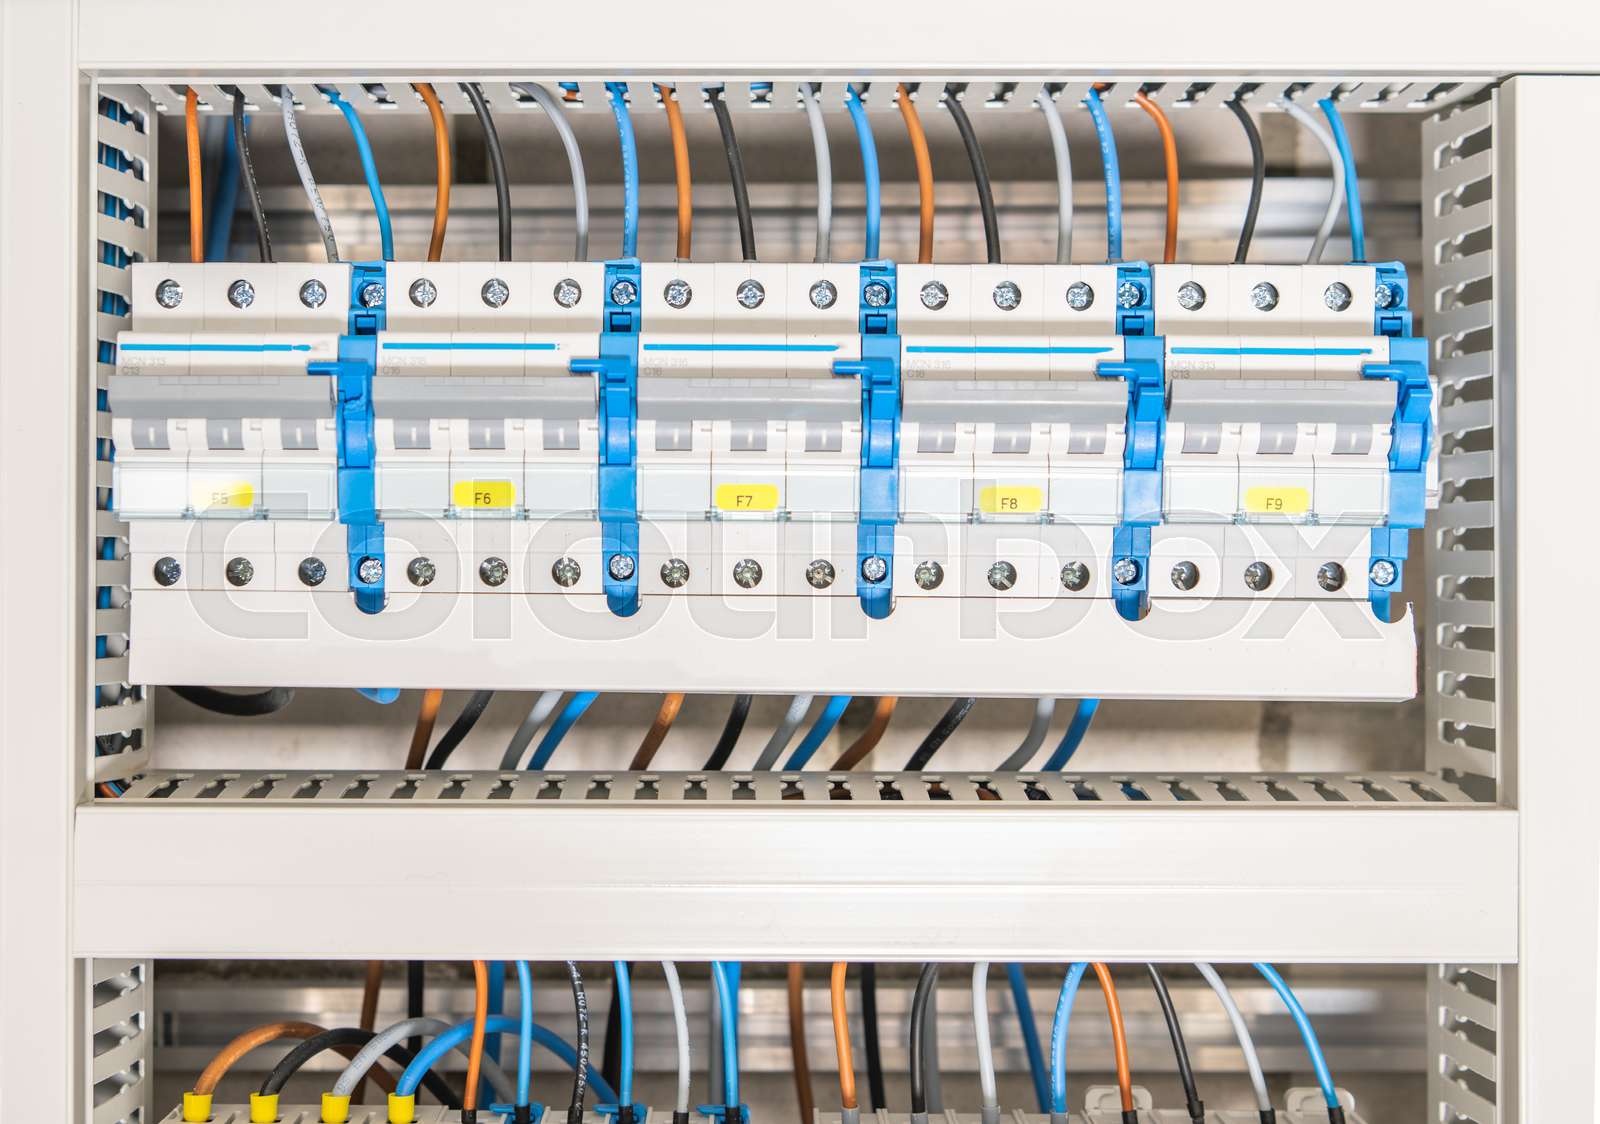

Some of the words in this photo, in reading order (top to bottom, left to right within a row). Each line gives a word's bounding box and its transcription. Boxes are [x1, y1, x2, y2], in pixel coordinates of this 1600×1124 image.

[474, 492, 492, 505] F6
[736, 494, 753, 507] F7
[1001, 497, 1018, 510] F8
[1266, 497, 1283, 510] F9
